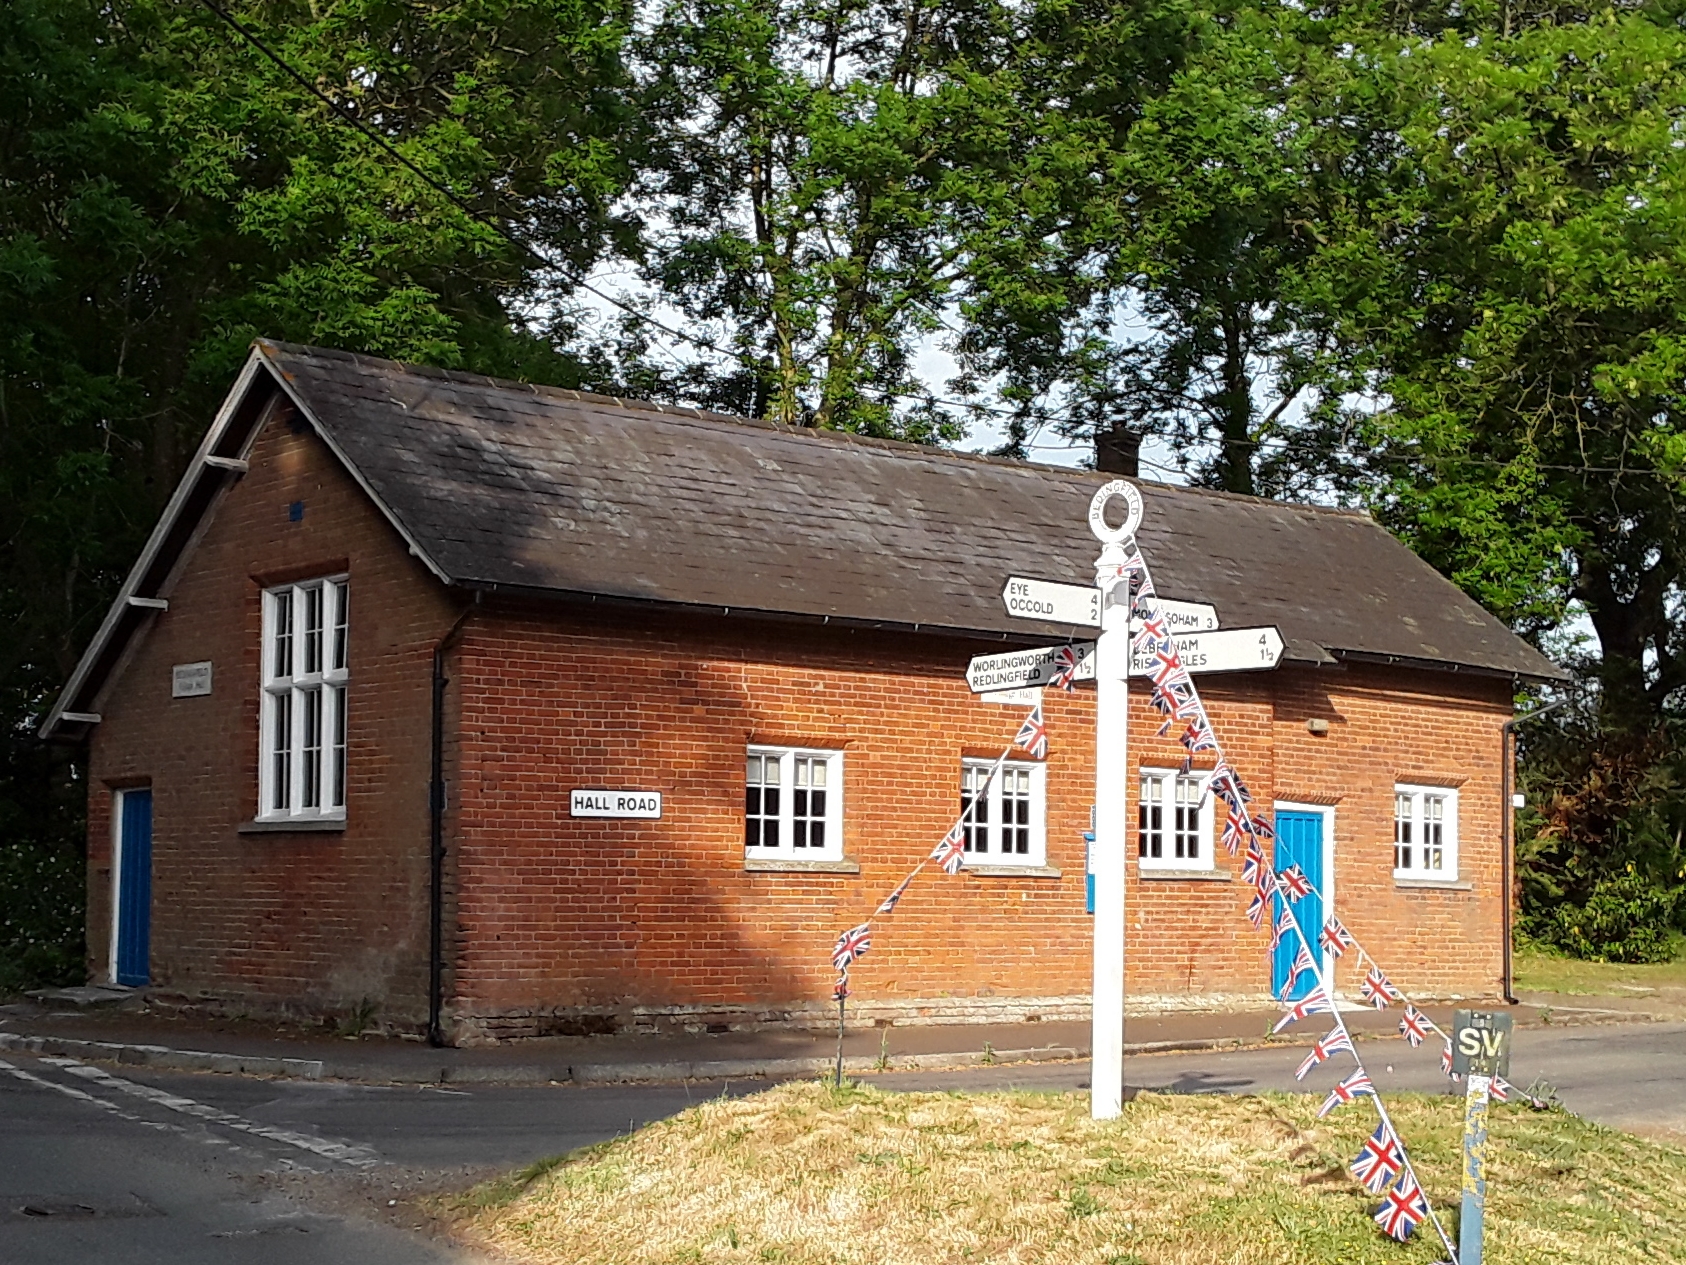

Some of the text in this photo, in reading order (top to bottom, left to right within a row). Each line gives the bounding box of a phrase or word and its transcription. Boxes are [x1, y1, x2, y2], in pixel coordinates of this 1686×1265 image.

[1092, 481, 1140, 520] BEDINGFIELD
[1010, 582, 1098, 605] EYE 4
[1010, 598, 1098, 620] OCCOLD 2
[1206, 618, 1213, 629] 3
[1133, 634, 1266, 655] DBEHAM 4
[973, 648, 1084, 673] WORLINGWORTH 3
[1133, 654, 1207, 670] RISGLES
[973, 669, 1040, 687] REDLINGFIELD
[574, 796, 657, 811] HALL ROAD
[1459, 1027, 1504, 1057] SV
